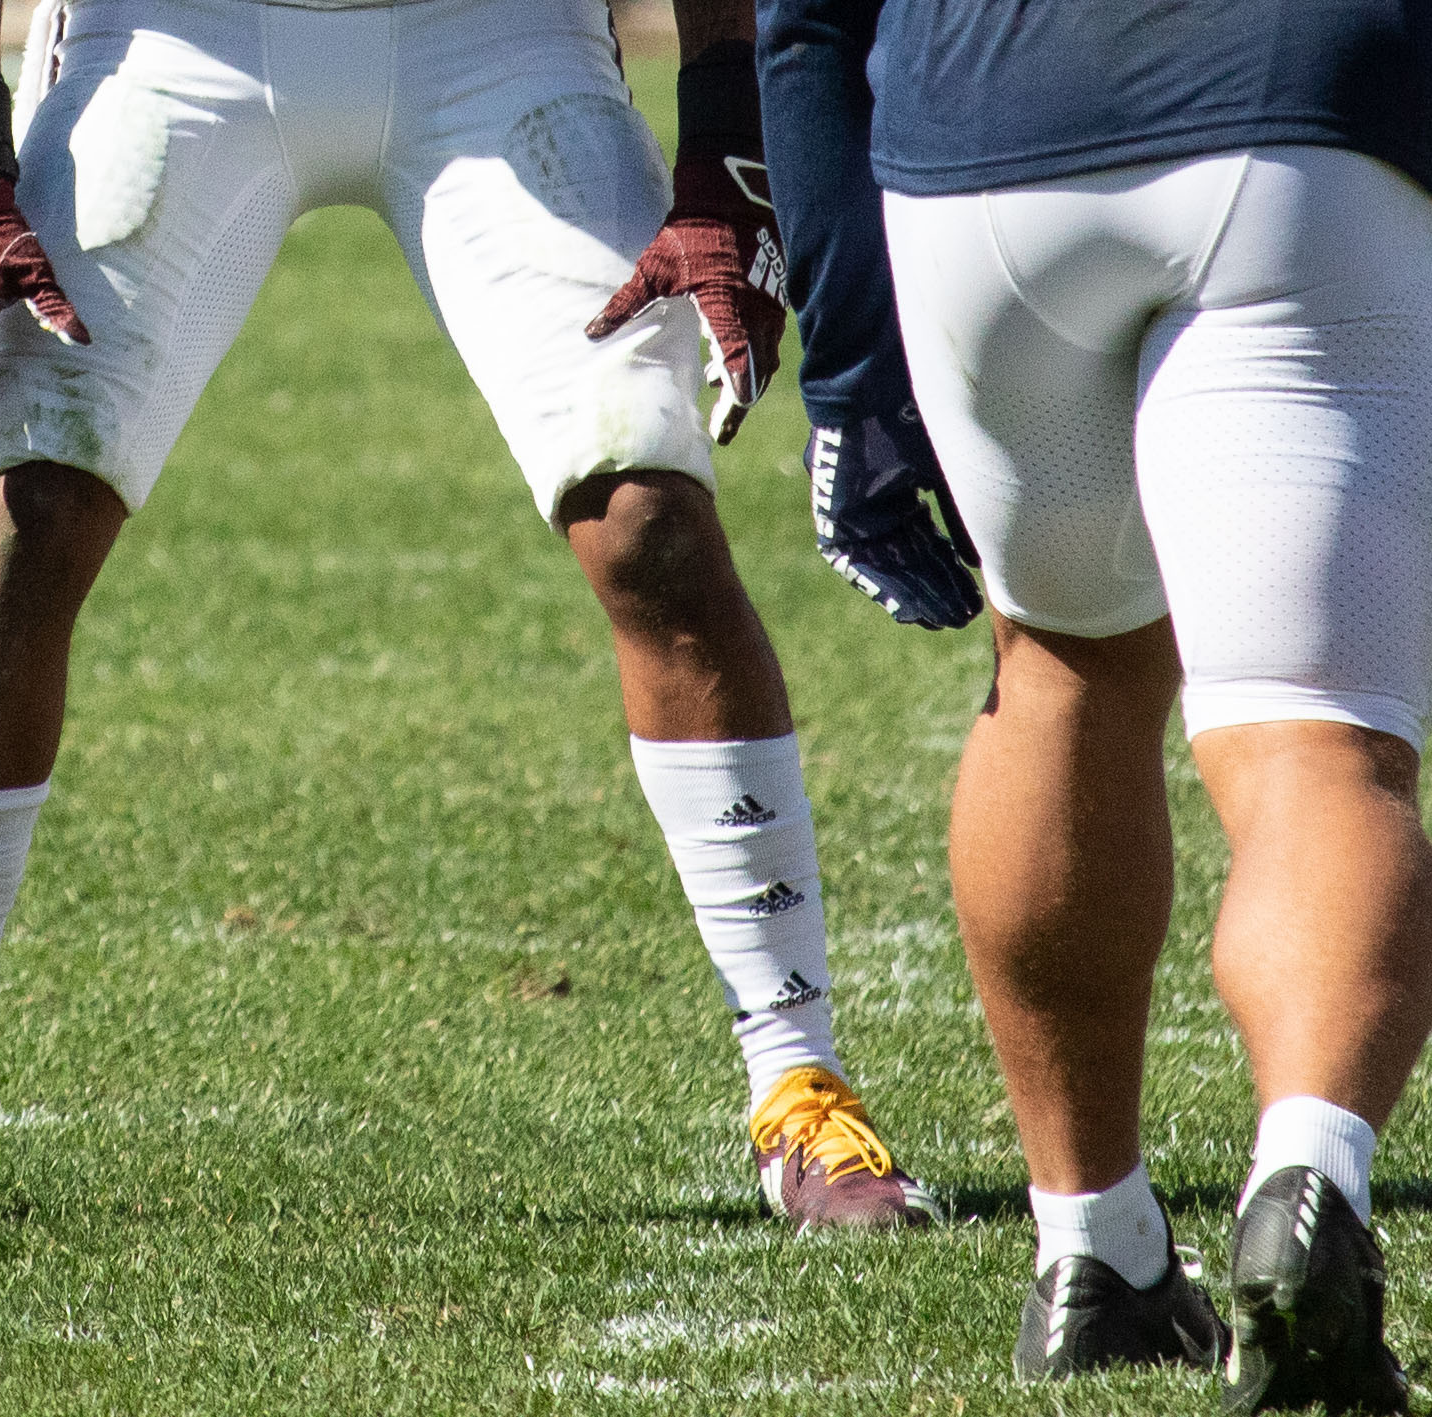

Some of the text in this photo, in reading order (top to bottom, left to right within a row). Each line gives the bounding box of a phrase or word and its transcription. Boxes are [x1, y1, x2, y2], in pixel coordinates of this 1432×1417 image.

[714, 809, 777, 827] adidas
[749, 892, 806, 915] adidas
[769, 986, 822, 1011] adidas
